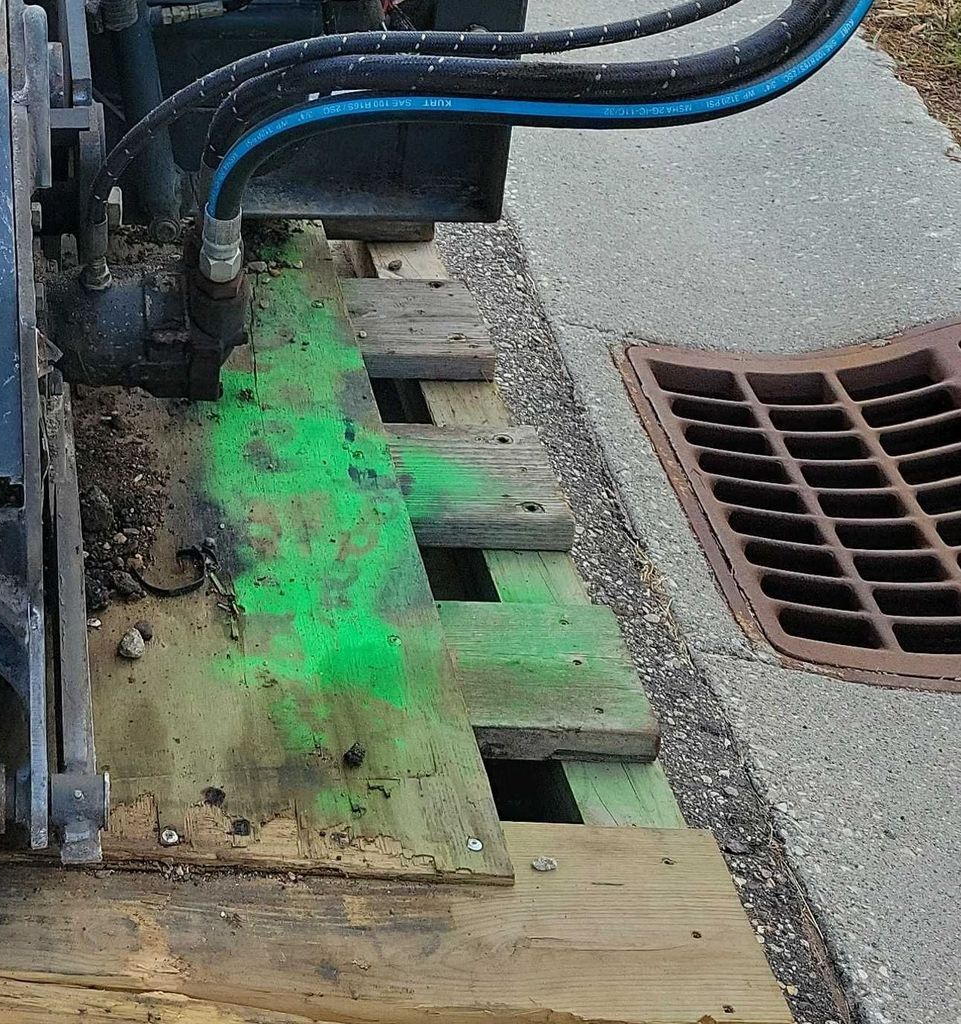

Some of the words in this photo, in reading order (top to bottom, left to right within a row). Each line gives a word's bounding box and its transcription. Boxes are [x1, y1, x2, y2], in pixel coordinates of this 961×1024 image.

[373, 100, 390, 108] 100
[391, 99, 412, 107] SAE
[422, 99, 452, 107] KURT
